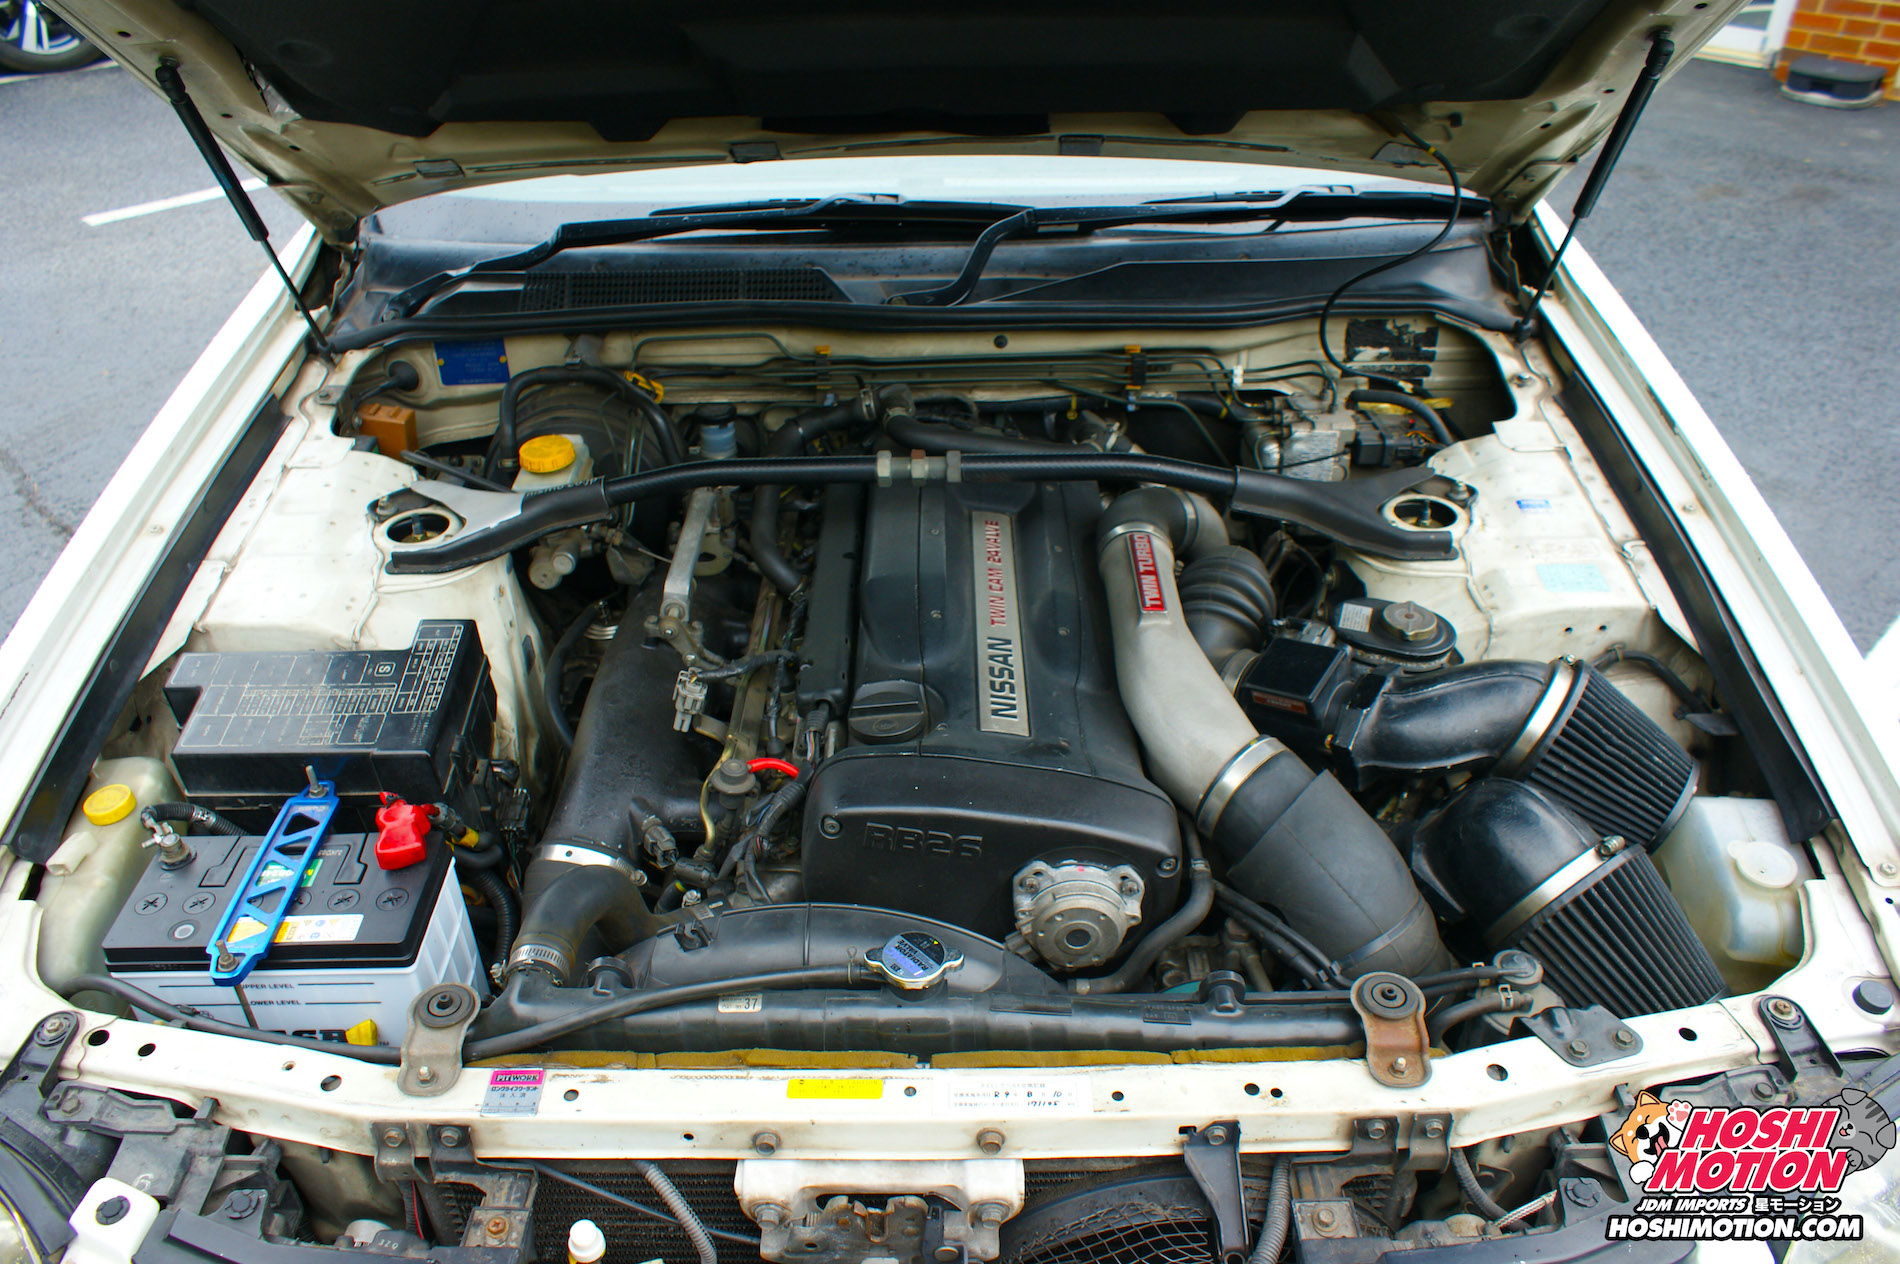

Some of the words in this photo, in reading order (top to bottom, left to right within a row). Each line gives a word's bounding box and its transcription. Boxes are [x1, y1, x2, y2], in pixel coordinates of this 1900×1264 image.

[984, 519, 1002, 564] 24VALVE
[1134, 534, 1155, 573] TURBO
[988, 567, 1004, 593] CAM
[1140, 574, 1162, 608] TWIN
[989, 595, 1006, 627] TWIN
[986, 636, 1018, 720] NISSAN
[864, 821, 983, 857] RB26
[894, 943, 930, 971] RADIATOR
[744, 997, 758, 1010] 37
